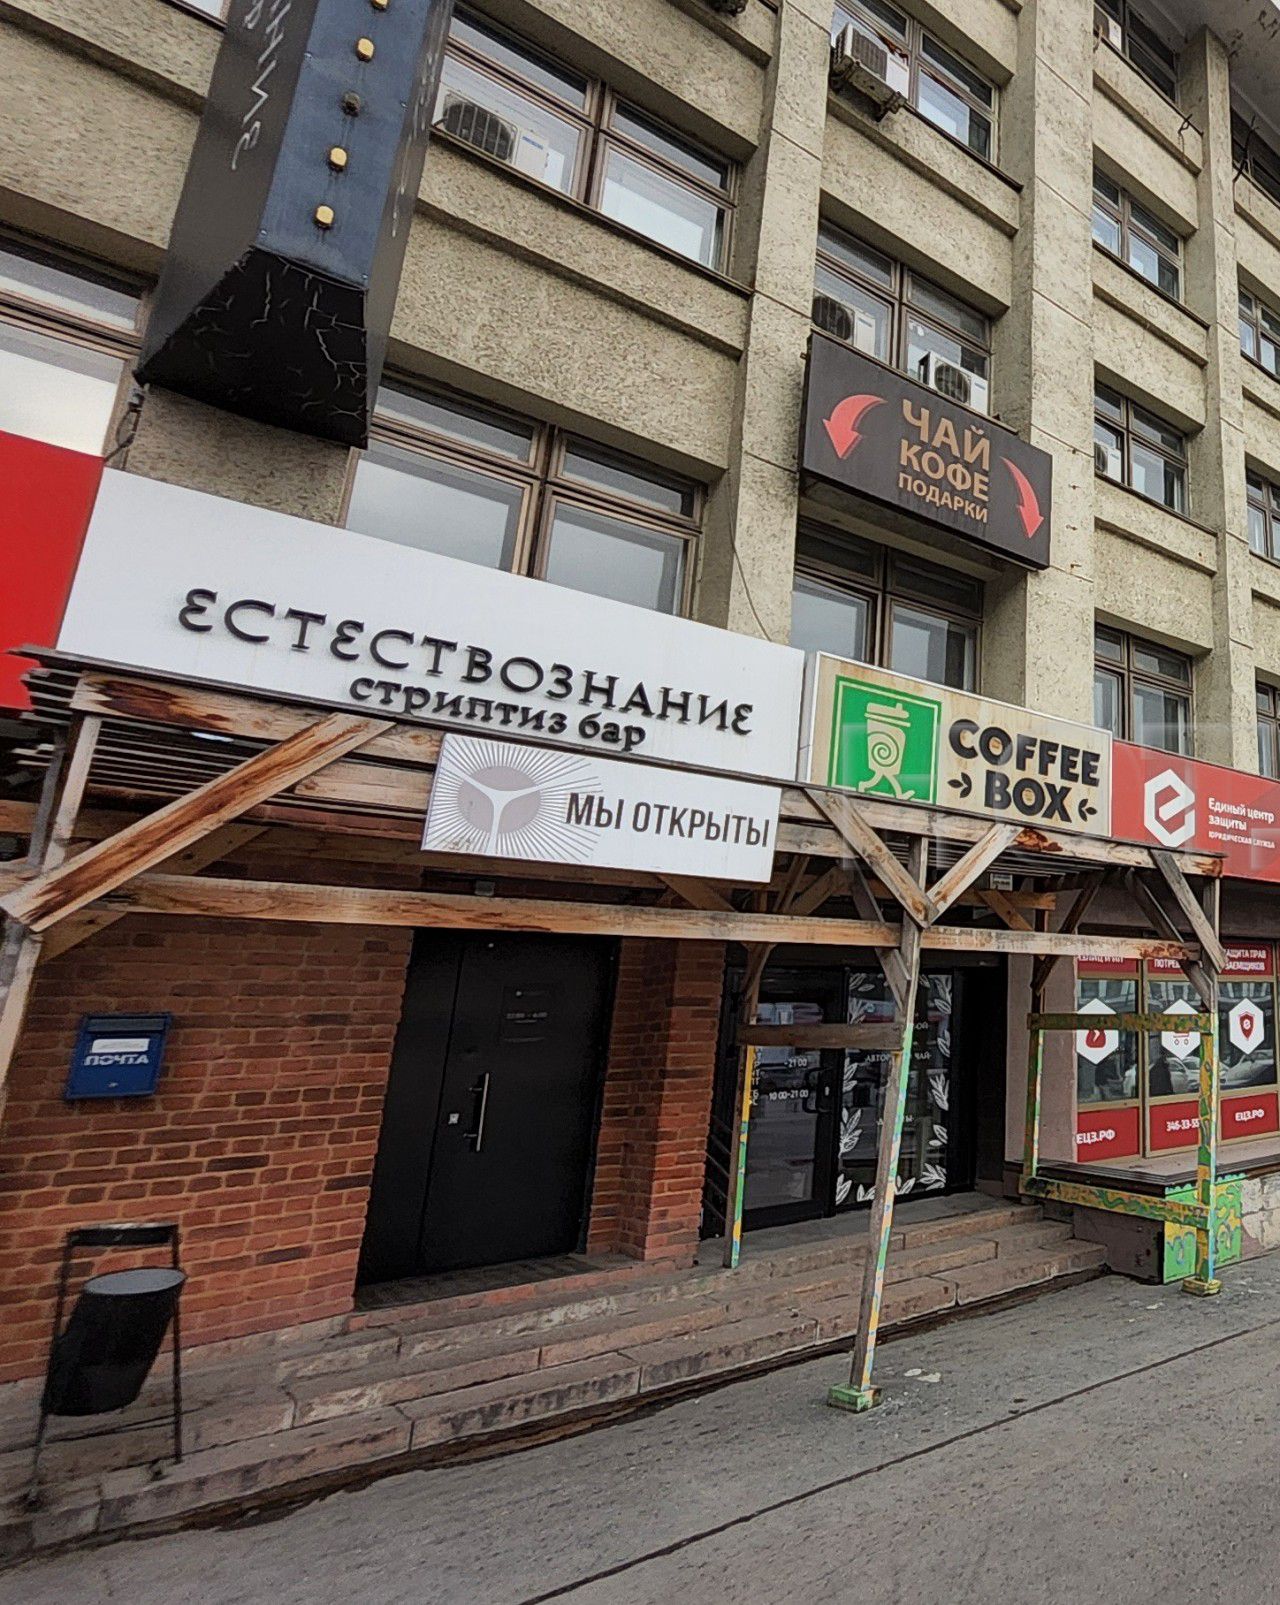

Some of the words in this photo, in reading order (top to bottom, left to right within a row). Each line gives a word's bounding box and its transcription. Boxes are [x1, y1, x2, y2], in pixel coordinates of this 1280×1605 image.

[902, 397, 990, 473] ЧАЙ
[900, 440, 990, 502] КОФЕ
[898, 472, 988, 523] ПОДАРКИ
[178, 588, 755, 736] ЕСТЕСТВОЗНАНИЕ
[350, 673, 567, 739] стриптиз
[579, 711, 647, 753] бар
[948, 719, 1101, 788] COFFEE
[565, 793, 624, 831] МЫ
[631, 801, 770, 849] ОТКРЫТЫ
[984, 776, 1072, 823] BOX
[1208, 797, 1246, 817] Единый
[1247, 807, 1275, 824] центр
[1208, 815, 1247, 830] защиты
[83, 1054, 150, 1067] ПОЧТА
[1075, 1129, 1116, 1146] ЕЦЗ.РФ
[1235, 1109, 1265, 1123] ЕЦЗ.РФ
